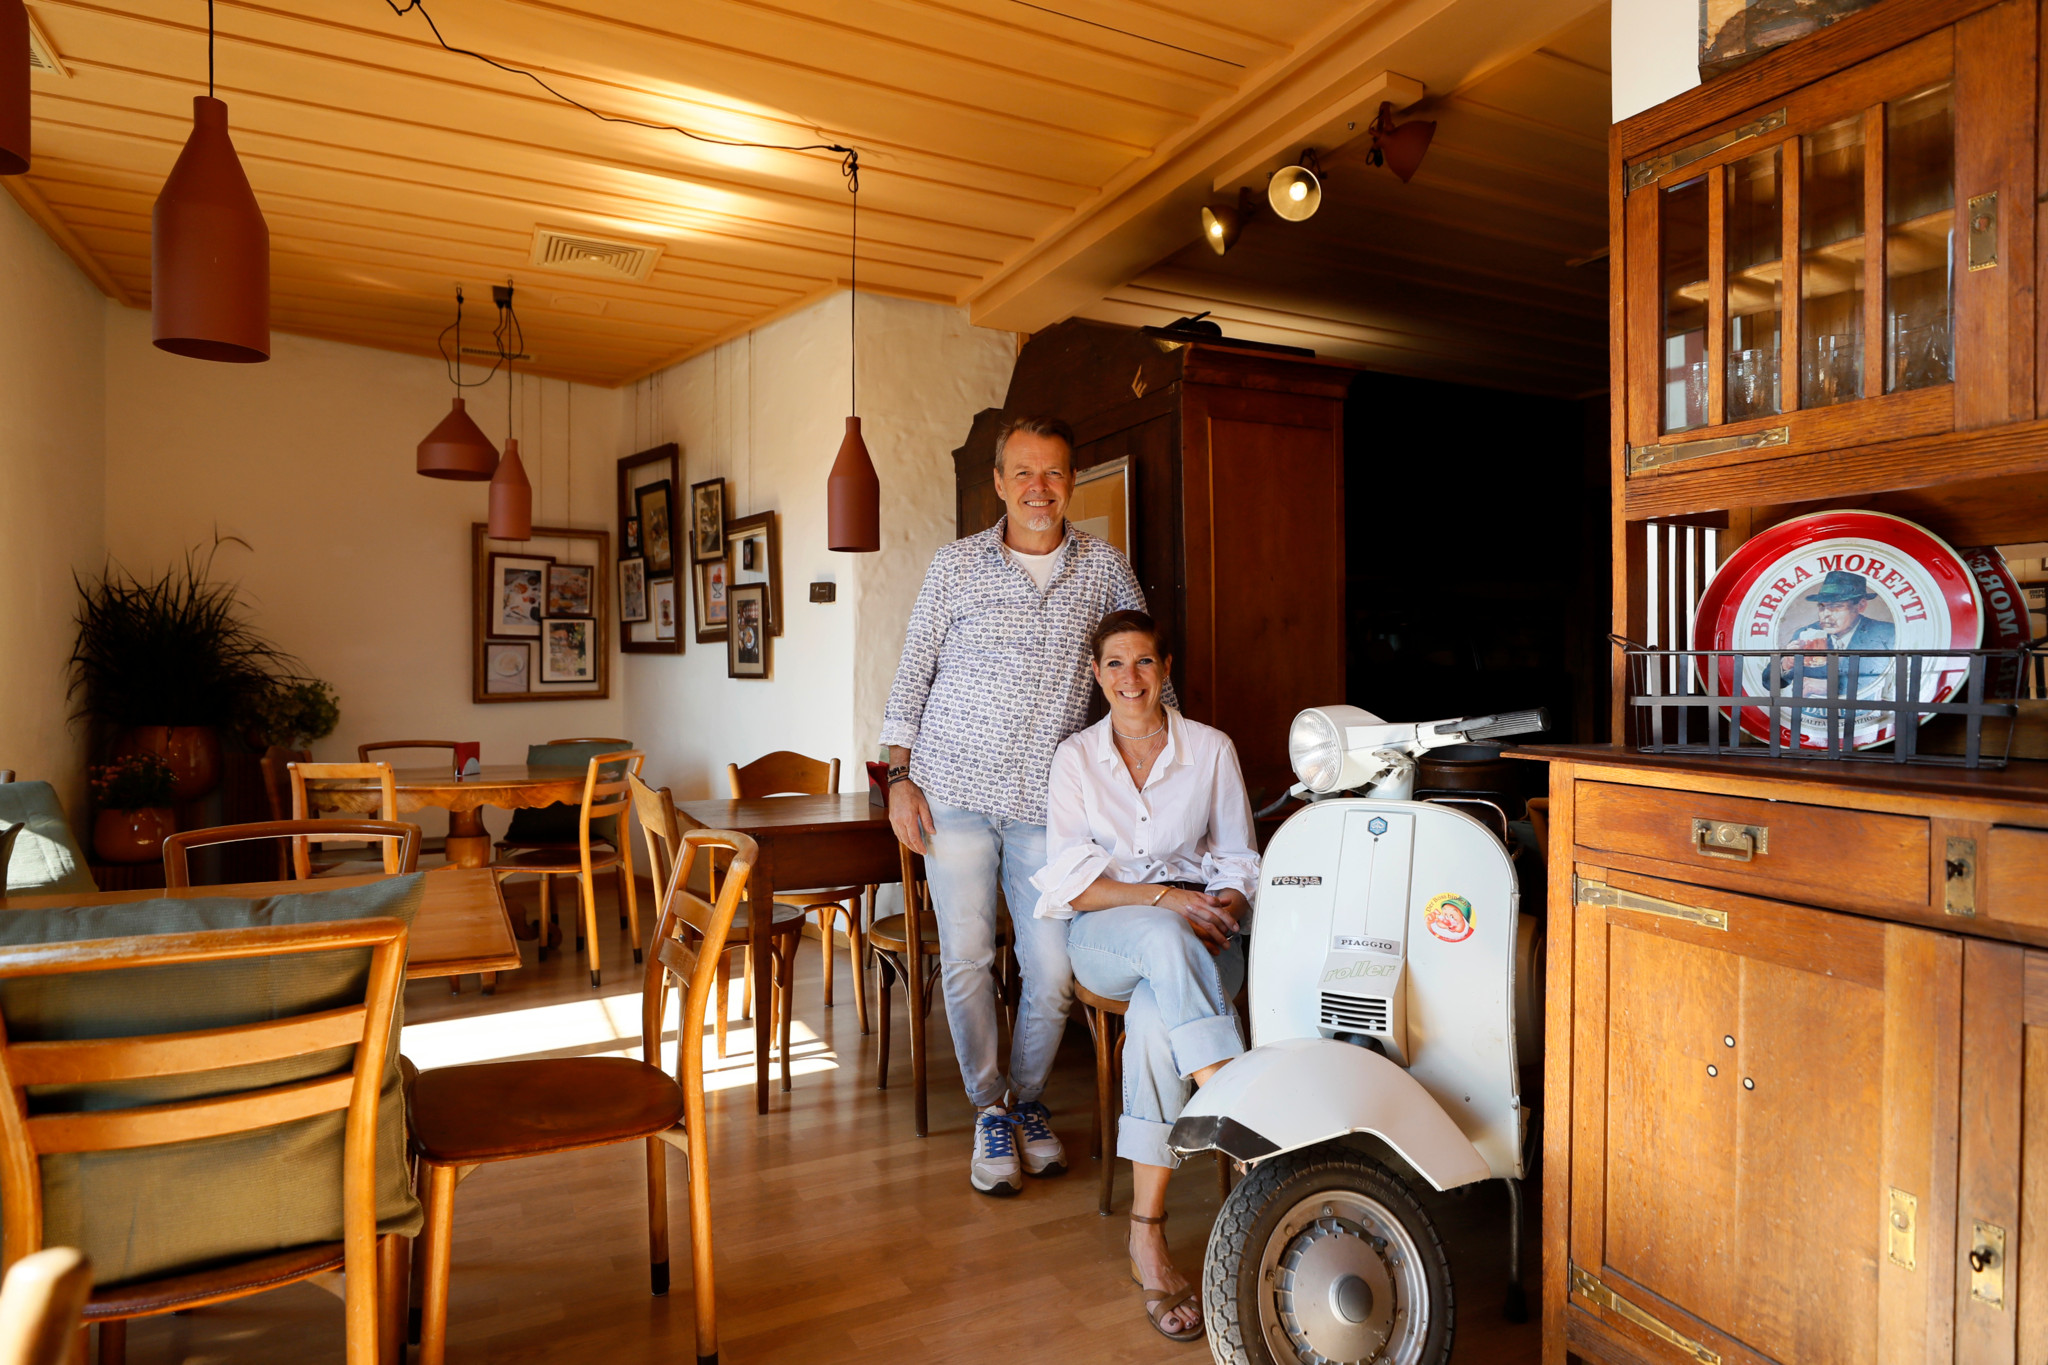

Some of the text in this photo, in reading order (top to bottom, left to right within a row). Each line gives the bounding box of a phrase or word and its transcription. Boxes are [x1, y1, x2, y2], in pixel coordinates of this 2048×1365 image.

[1750, 553, 1927, 638] BIRRA MORETTI
[1272, 876, 1322, 888] vespa
[1340, 938, 1393, 950] PIAGGIO
[1323, 960, 1396, 982] roller
